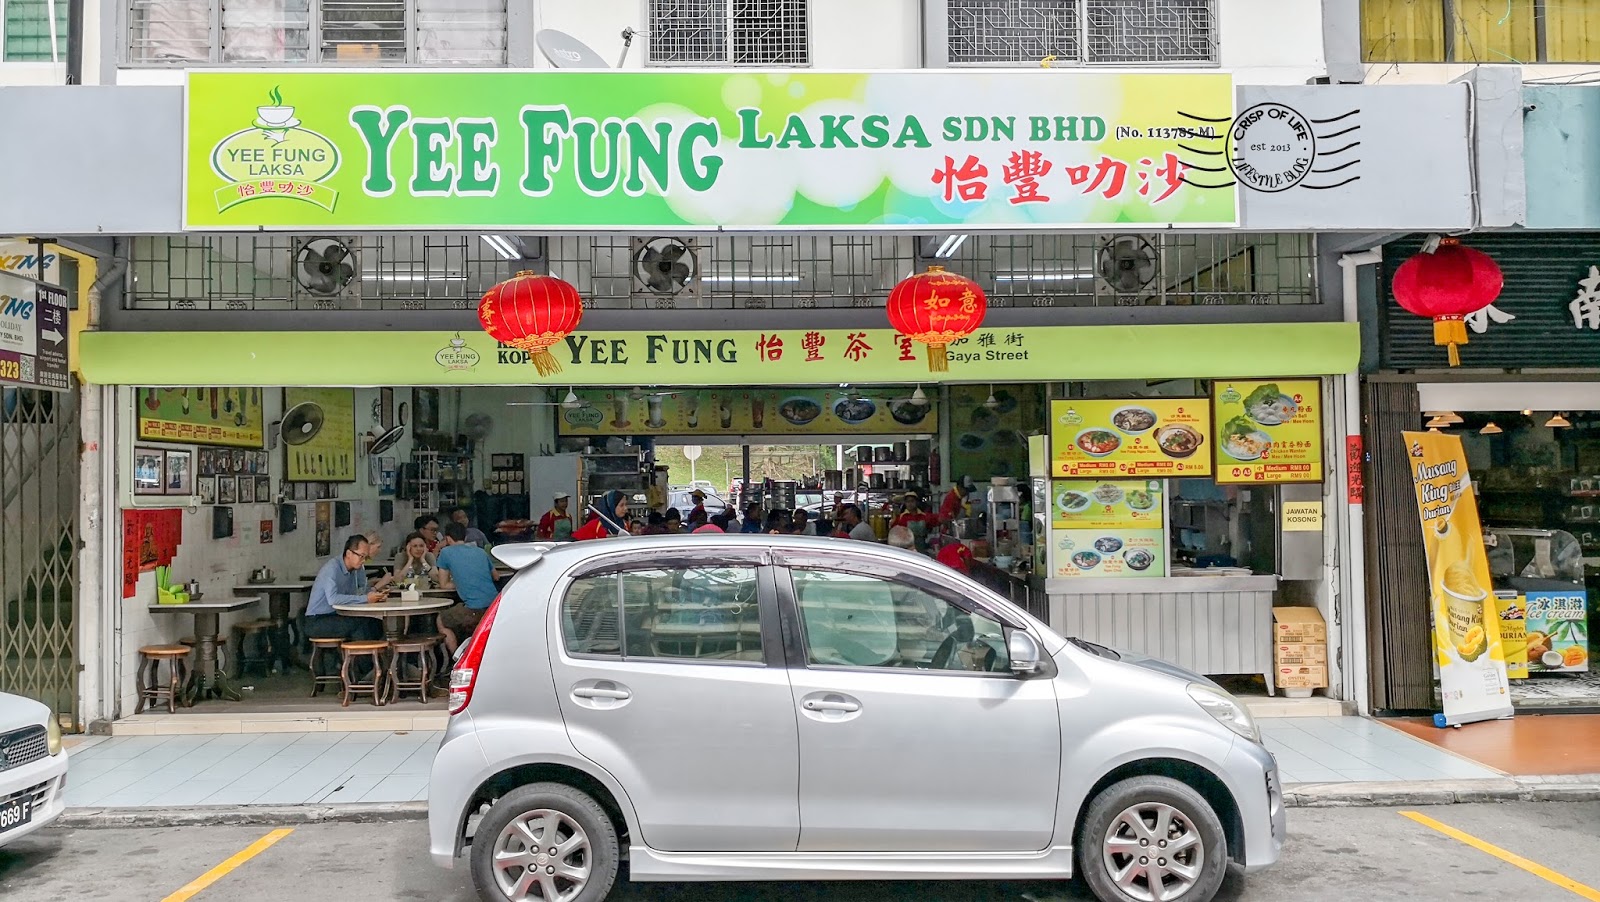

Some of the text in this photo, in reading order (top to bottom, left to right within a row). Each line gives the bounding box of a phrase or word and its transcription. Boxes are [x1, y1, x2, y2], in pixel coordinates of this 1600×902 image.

[738, 108, 1106, 149] LAKSA SDN BHD
[1116, 126, 1142, 141] (No.
[227, 148, 325, 162] YEE FUNG
[351, 107, 725, 195] YEE FUNG
[249, 164, 304, 175] LAKSA
[931, 150, 1190, 204] 怡豐叻沙
[38, 289, 67, 308] 1st FLOOR
[923, 287, 977, 314] 如意
[564, 334, 737, 365] YEE FUNG
[755, 331, 916, 363] 怡豐茶室
[946, 350, 1029, 363] Gaya Street
[0, 359, 19, 379] 323
[1415, 459, 1457, 484] Musang
[1421, 483, 1448, 504] King
[1423, 505, 1452, 521] Durian
[1547, 610, 1584, 619] cream
[23, 801, 30, 820] F
